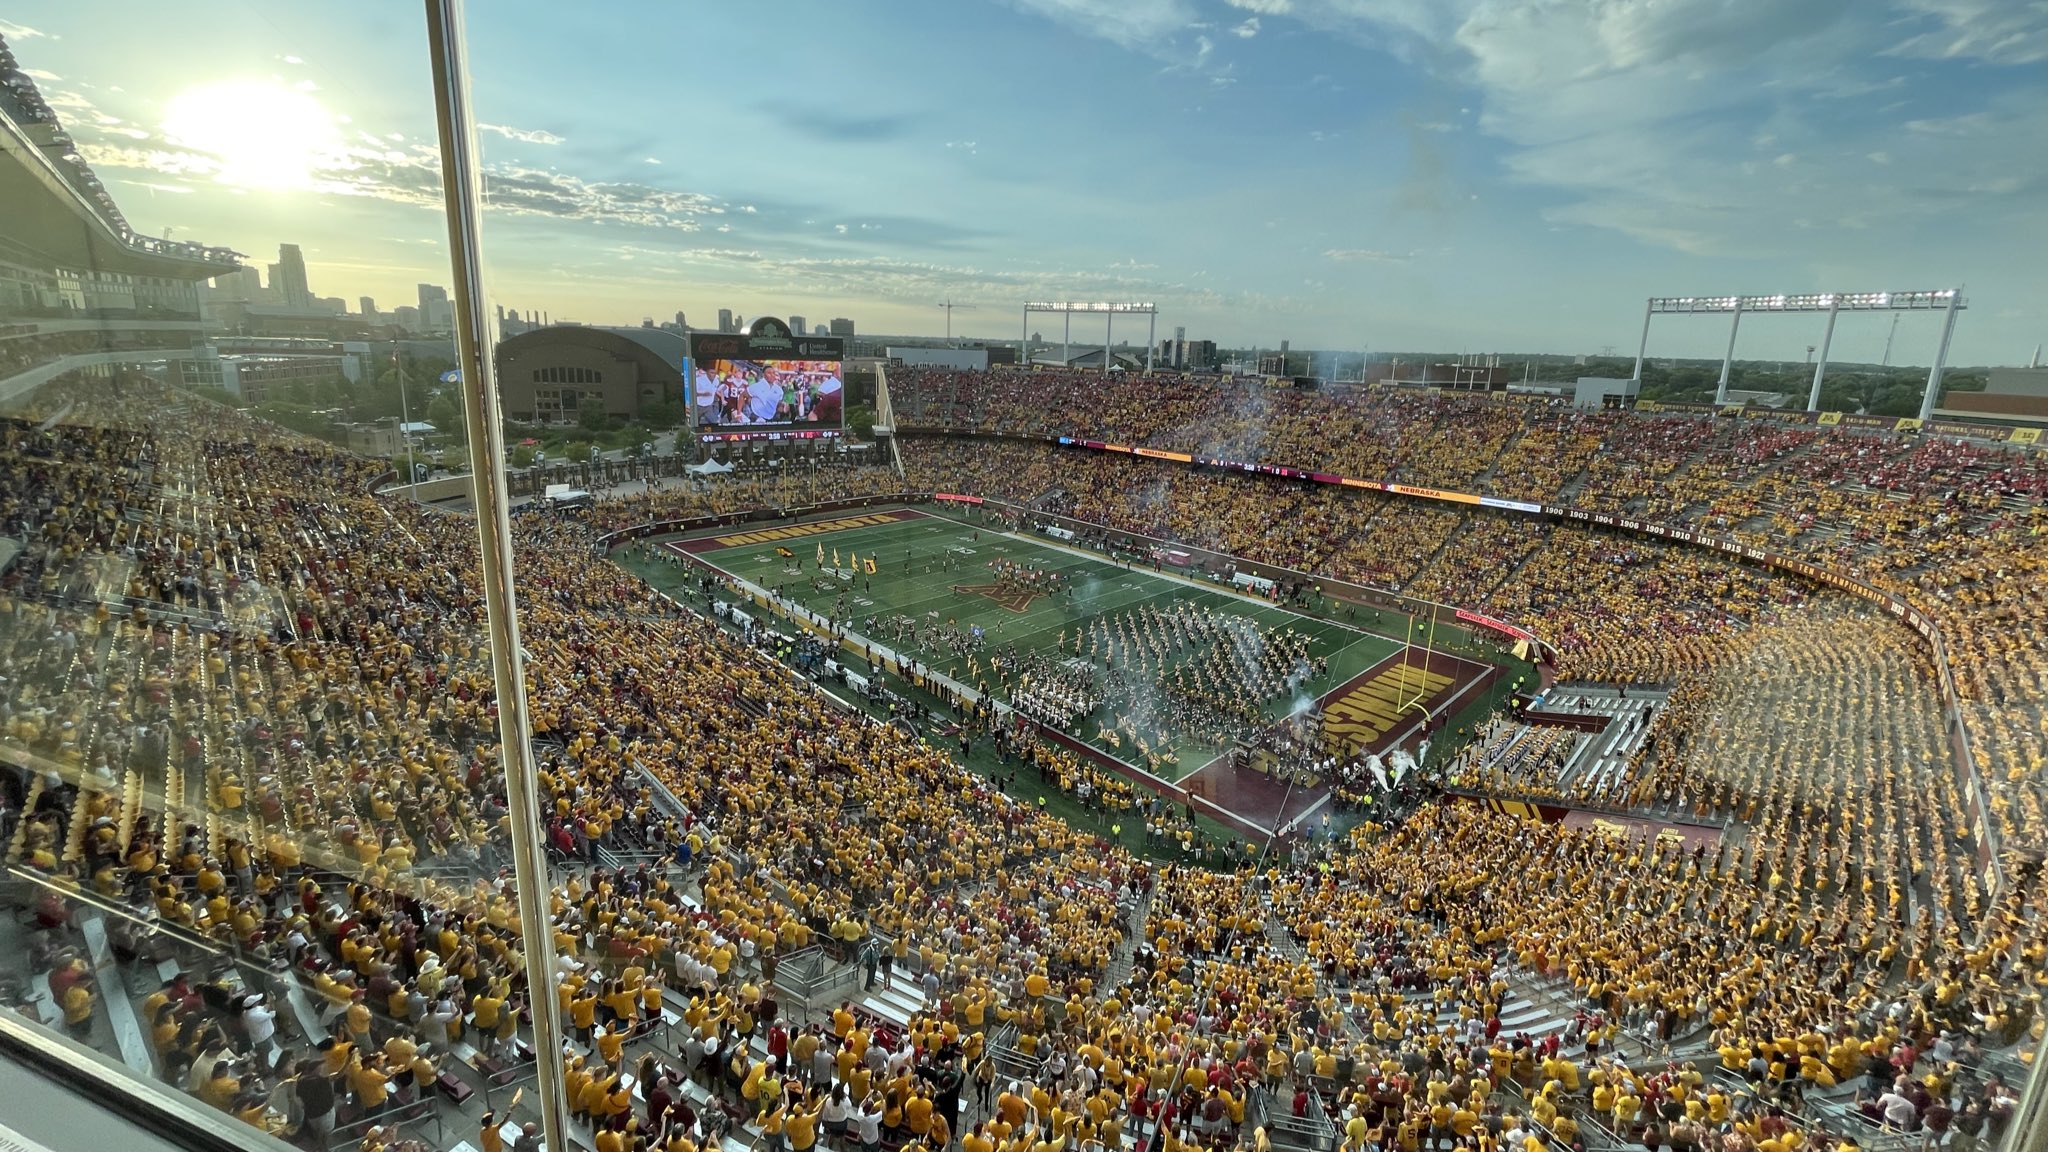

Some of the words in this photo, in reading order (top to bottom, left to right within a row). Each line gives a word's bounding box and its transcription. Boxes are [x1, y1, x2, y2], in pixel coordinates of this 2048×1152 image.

[1341, 478, 1382, 490] MINNESOTA
[1400, 486, 1441, 498] NEBRASKA
[714, 513, 900, 547] MINNESOTA
[1545, 506, 1564, 515] 1900
[1570, 510, 1589, 520] 1903
[1594, 514, 1614, 525] 1904
[1645, 524, 1665, 534] 1909
[1670, 530, 1690, 540] 1910
[1696, 536, 1715, 547] 1911
[1721, 542, 1742, 553] 1915
[1747, 548, 1766, 560] 1927
[1775, 557, 1794, 568] BIG
[1799, 563, 1815, 576] TEN
[1820, 571, 1886, 605] CHAMPIONSHIPS
